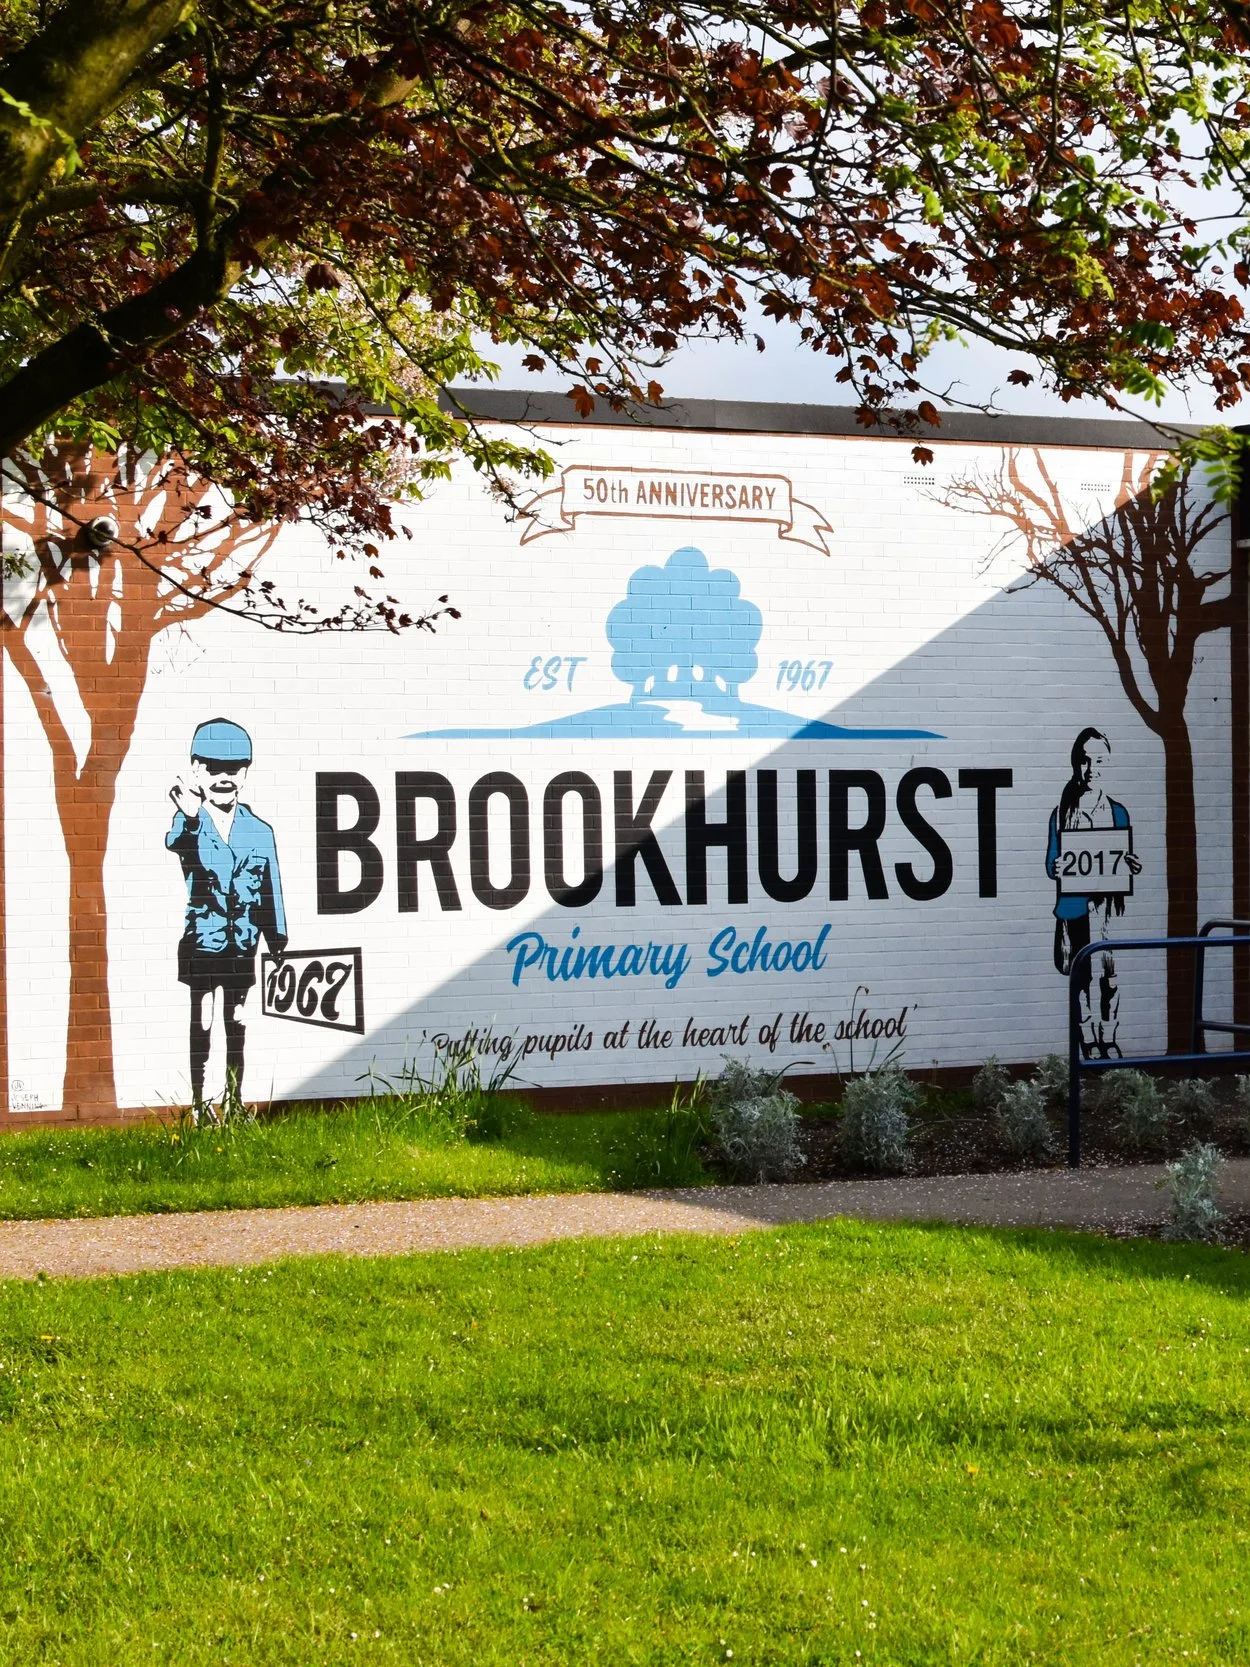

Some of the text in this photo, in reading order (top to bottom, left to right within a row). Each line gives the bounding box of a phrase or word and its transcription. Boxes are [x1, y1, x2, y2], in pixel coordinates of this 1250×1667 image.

[583, 477, 776, 510] 50th ANNIVERSARY
[523, 655, 588, 692] EST
[775, 658, 834, 692] 1967
[315, 766, 1013, 915] BROOKHURST
[1062, 850, 1123, 876] 2017
[506, 923, 833, 990] Primary School
[266, 959, 353, 1021] 1967
[522, 1023, 594, 1061] pupils
[603, 1019, 631, 1050] at
[637, 1018, 674, 1050] the
[682, 1014, 751, 1048] heart
[758, 1012, 784, 1054] of
[789, 1010, 828, 1044] the
